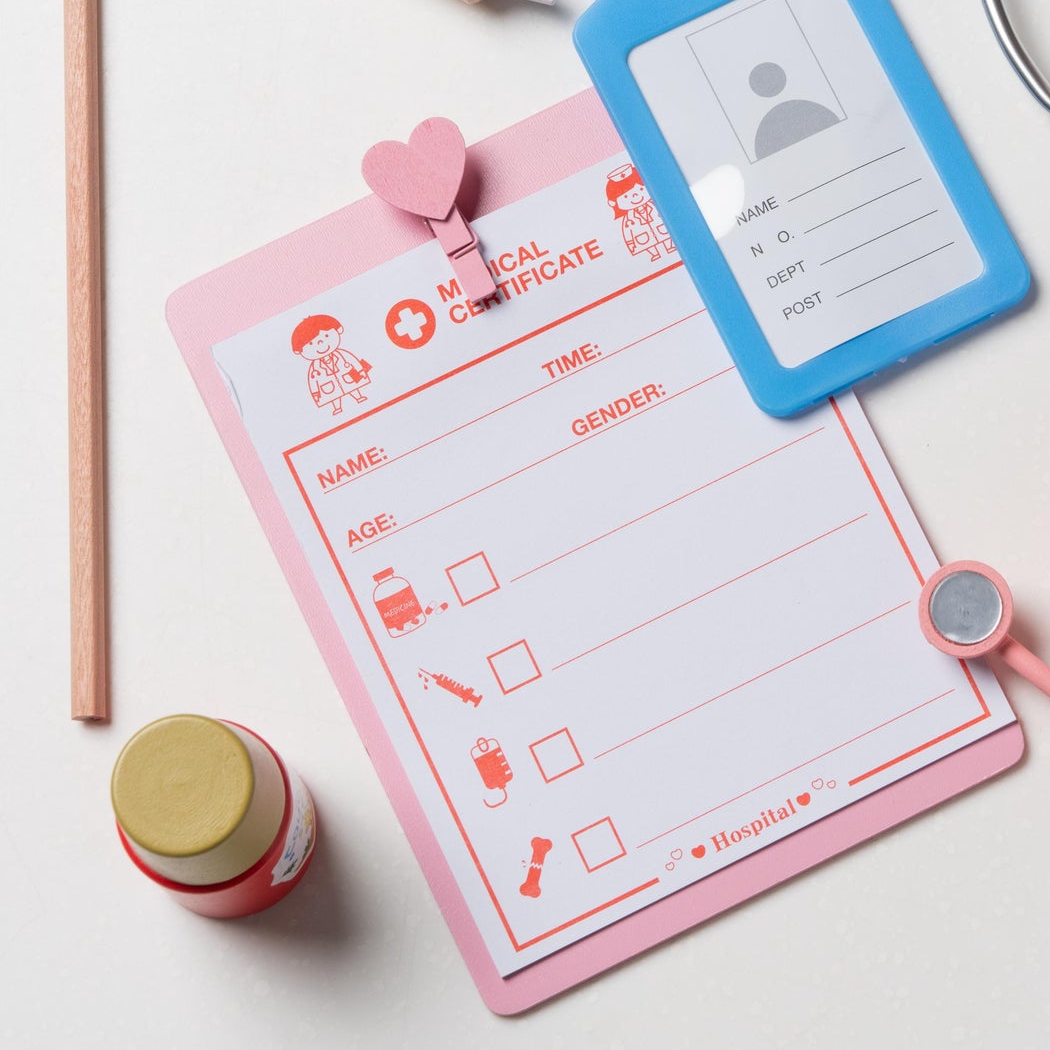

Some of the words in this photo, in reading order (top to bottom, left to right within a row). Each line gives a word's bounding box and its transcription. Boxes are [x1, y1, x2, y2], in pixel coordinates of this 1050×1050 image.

[736, 196, 780, 226] NAME
[436, 241, 550, 303] MICAL
[449, 239, 604, 324] CERTIFICATE
[766, 260, 807, 289] DEPT
[782, 291, 824, 320] POST
[541, 342, 603, 379] TIME:
[571, 382, 667, 437] GENDER:
[316, 446, 388, 489] NAME:
[346, 512, 397, 548] AGE:
[710, 798, 798, 854] Hospital
